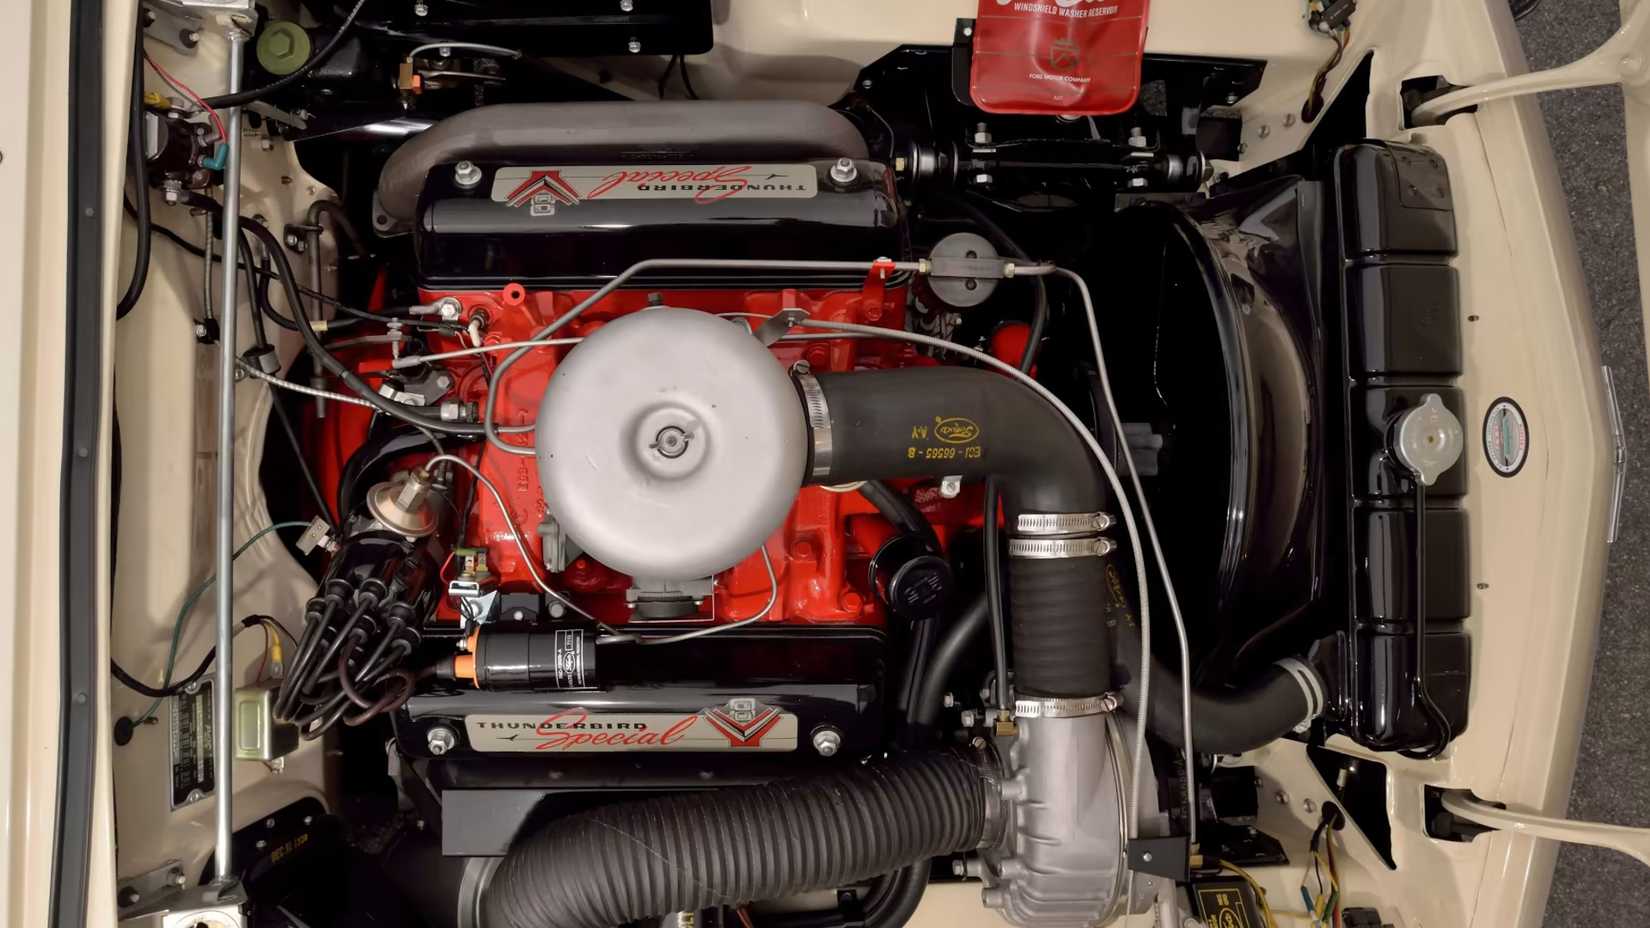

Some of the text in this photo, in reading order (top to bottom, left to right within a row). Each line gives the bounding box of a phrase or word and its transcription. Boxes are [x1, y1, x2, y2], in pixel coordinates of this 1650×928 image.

[1014, 2, 1057, 15] WINDSHIELD
[1059, 7, 1088, 17] WASHER
[1087, 5, 1119, 17] RESERVOIR
[587, 166, 752, 205] Special
[637, 183, 806, 192] THUNDERBIRD
[477, 721, 647, 730] THUNDERBIRD
[535, 707, 699, 749] Special
